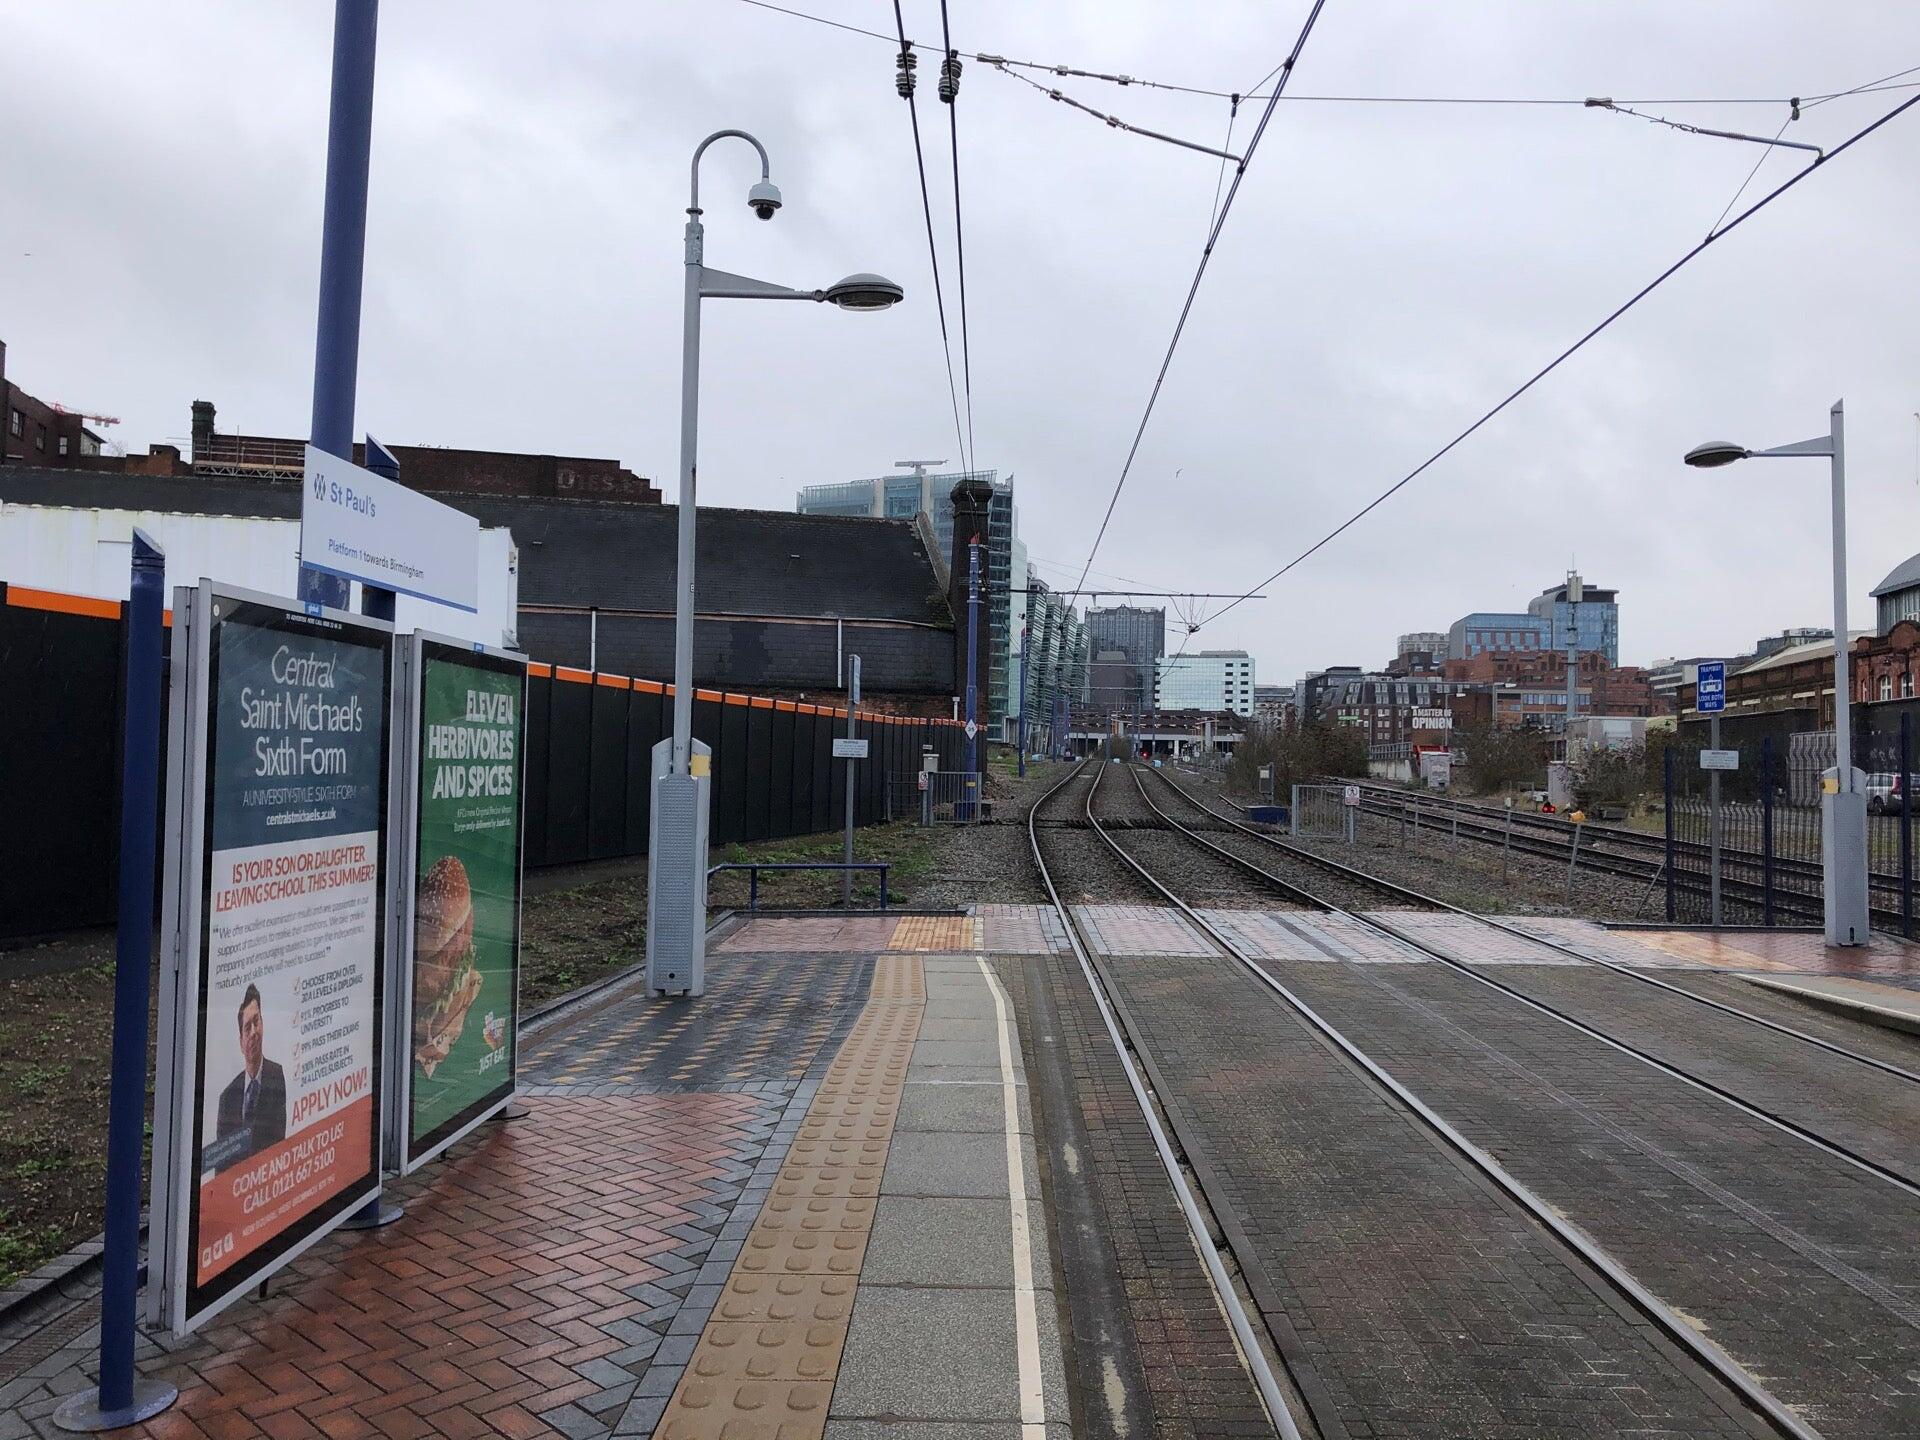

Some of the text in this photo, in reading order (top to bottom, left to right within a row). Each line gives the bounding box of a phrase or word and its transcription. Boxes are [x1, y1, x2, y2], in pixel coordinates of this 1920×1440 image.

[330, 482, 376, 518] St Paul's
[328, 539, 425, 580] Platform 1 towards Birmingham
[271, 645, 336, 689] Central
[1700, 664, 1722, 673] TRAMWAY
[241, 687, 362, 732] Saint Michael's
[466, 689, 513, 725] ELEVEN
[1418, 708, 1443, 716] MATTER
[1444, 708, 1452, 716] OF
[1699, 694, 1710, 702] LOOK
[1704, 700, 1717, 708] WAYS
[428, 724, 513, 760] HERBIVORES
[255, 737, 346, 776] Sixth Form
[315, 786, 335, 802] SIXTH
[432, 765, 512, 799] AND SPICES
[232, 845, 365, 884] IS YOUR SON OR DAUGHTER
[216, 864, 375, 912] LEAVING SCHOOL THIS SUMMER?
[217, 943, 241, 957] support
[216, 958, 245, 976] preparing
[301, 964, 355, 990] CHOOSE FROM OVER
[215, 975, 242, 989] maturity
[313, 984, 332, 999] LEVELS
[338, 973, 362, 991] DIPLOMAS
[313, 998, 340, 1018] PROGRESS
[341, 995, 348, 1007] TO
[301, 1014, 332, 1035] UNIVERSITY
[312, 1035, 325, 1048] PASS
[326, 1028, 341, 1042] THEIR
[342, 1021, 359, 1037] EXAMS
[312, 1066, 328, 1082] LEVEL
[328, 1054, 352, 1074] SUBJECTS
[314, 1053, 328, 1067] PASS
[329, 1047, 342, 1061] RATE
[343, 1045, 349, 1055] IN
[479, 1046, 506, 1076] JUST EAT
[291, 1066, 367, 1126] APPLY NOW!
[232, 1163, 267, 1197] COME
[268, 1152, 290, 1179] AND
[291, 1137, 314, 1165] TALK
[316, 1130, 329, 1150] TO
[330, 1121, 344, 1142] US!
[243, 1147, 334, 1214] CALL 0121 667 5100
